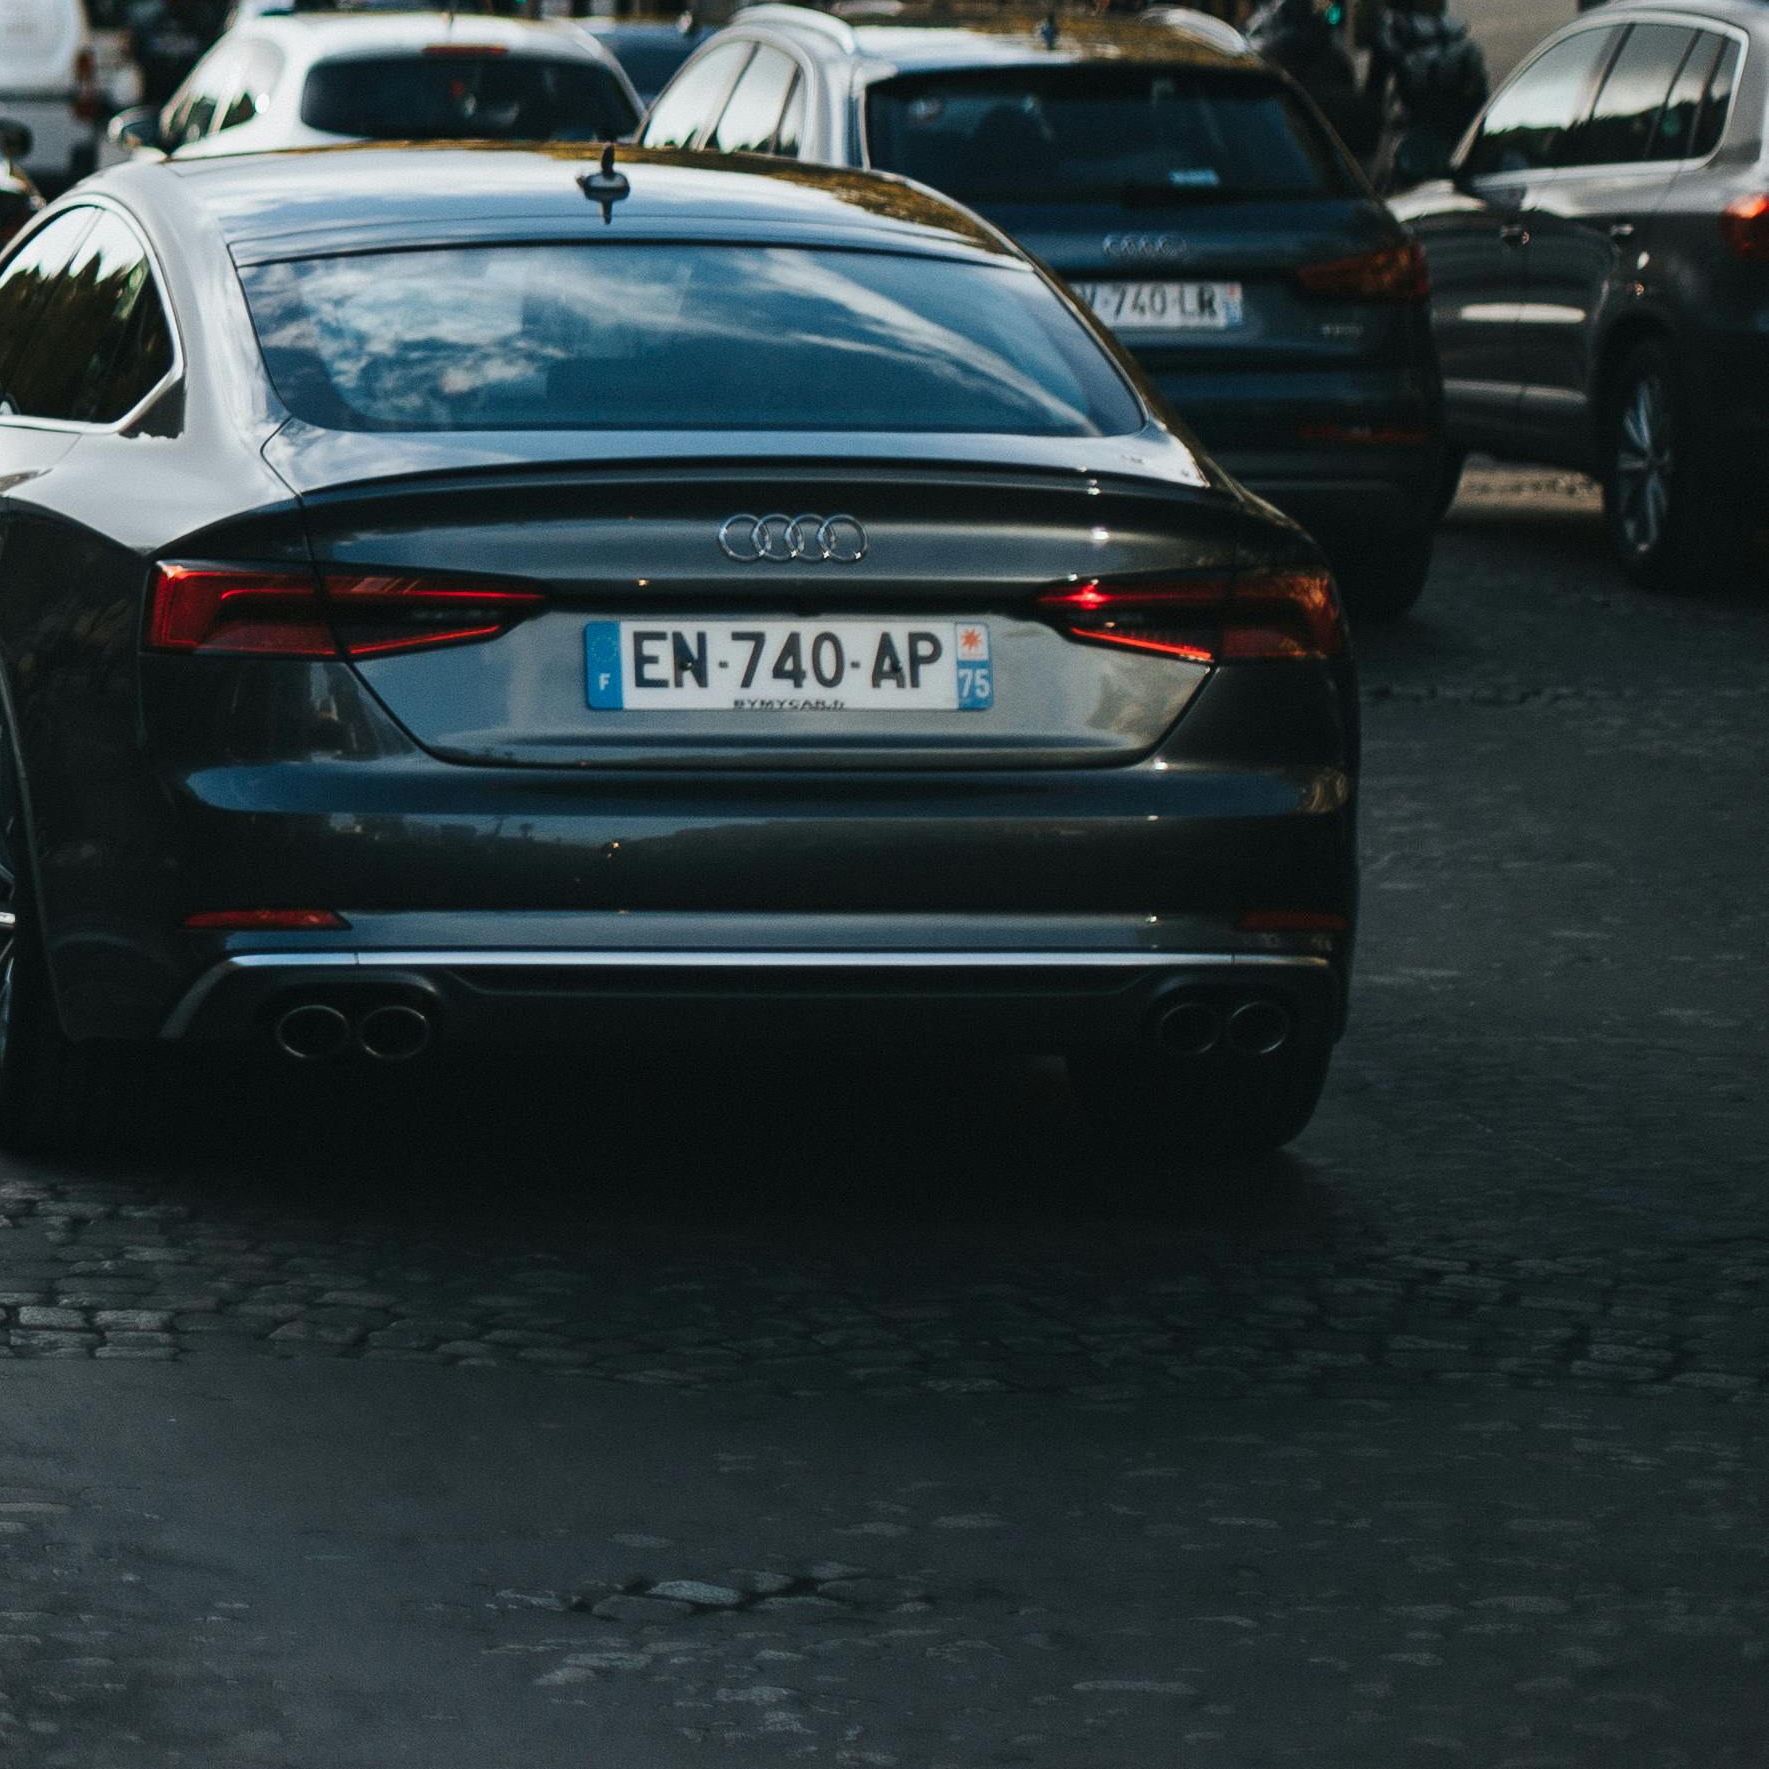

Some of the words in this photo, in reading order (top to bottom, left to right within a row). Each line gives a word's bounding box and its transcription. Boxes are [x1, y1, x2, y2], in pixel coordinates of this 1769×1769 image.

[632, 631, 943, 689] EN-740-AP
[599, 673, 610, 691] F
[959, 668, 991, 698] 75
